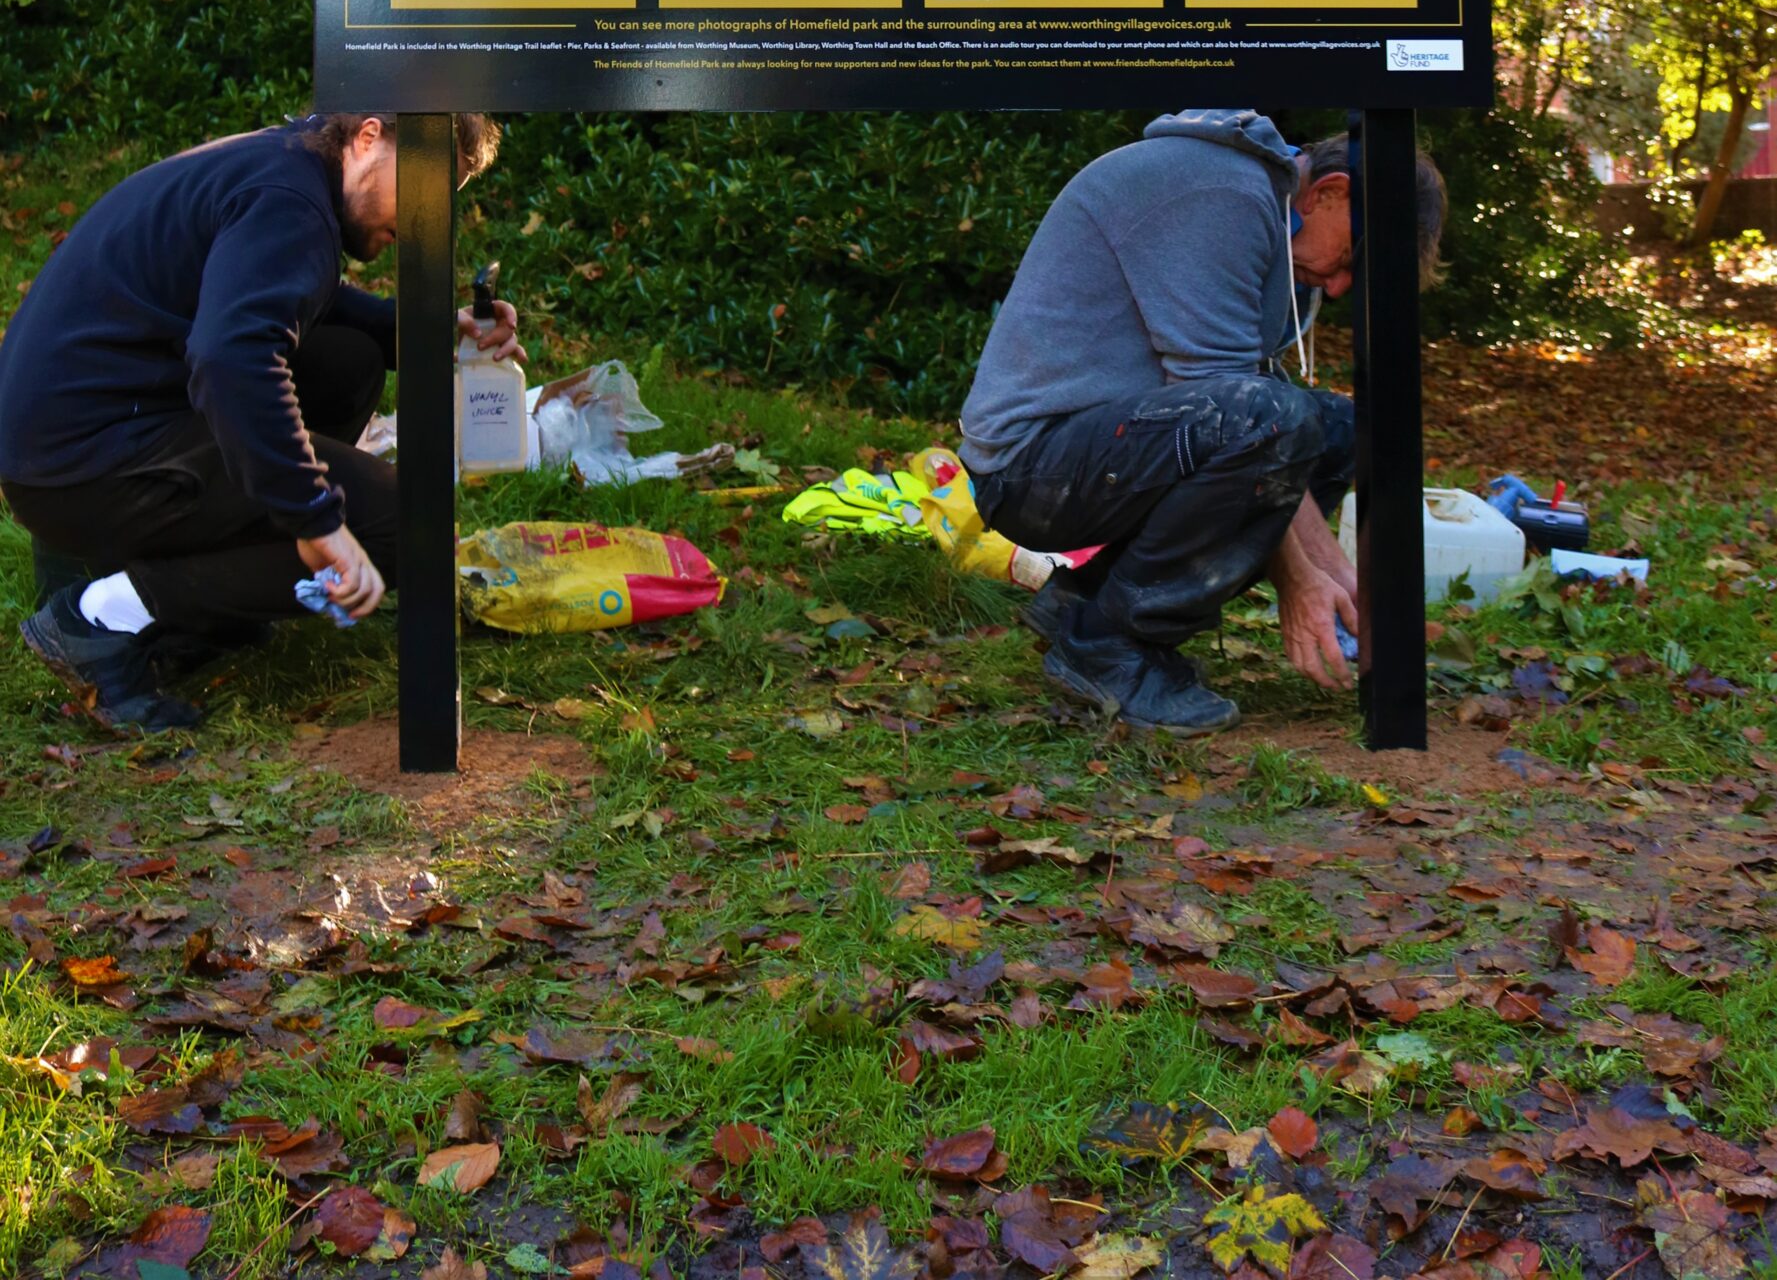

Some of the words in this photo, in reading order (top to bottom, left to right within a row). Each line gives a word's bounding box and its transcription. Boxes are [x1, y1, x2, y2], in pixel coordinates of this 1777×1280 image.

[594, 19, 615, 30] You
[619, 22, 639, 30] can
[642, 22, 661, 30] see
[665, 22, 694, 30] more
[698, 18, 771, 32] photographs
[774, 18, 786, 29] of
[790, 18, 849, 29] Homefield
[852, 18, 878, 32] park
[881, 18, 902, 29] and
[905, 18, 924, 29] the
[927, 18, 995, 32] surrounding
[998, 21, 1022, 29] area
[1026, 20, 1036, 29] at
[1039, 18, 1231, 31] www.worthingvillagevoices.org.uk
[345, 42, 381, 50] Homefield
[458, 42, 491, 51] Worthing
[492, 42, 523, 51] Heritage
[567, 42, 582, 50] Pier,
[611, 41, 639, 49] Seafront
[645, 41, 676, 49] available
[677, 41, 694, 49] from
[695, 41, 727, 50] Worthing
[729, 41, 760, 49] Museum,
[761, 41, 793, 50] Worthing
[795, 41, 820, 50] Library,
[821, 41, 853, 50] Worthing
[1143, 40, 1165, 49] phone
[1180, 40, 1200, 48] which
[1214, 40, 1228, 48] also
[1239, 40, 1259, 48] found
[1410, 53, 1450, 61] HERITAGE
[593, 60, 609, 68] The
[611, 59, 642, 68] Friends
[644, 59, 653, 68] of
[655, 59, 699, 68] Homefield
[701, 59, 719, 68] Park
[737, 59, 765, 69] always
[767, 59, 798, 69] looking
[800, 59, 812, 68] for
[834, 60, 879, 69] supporters
[880, 59, 896, 68] and
[918, 59, 940, 67] ideas
[942, 58, 954, 67] for
[955, 59, 969, 67] the
[971, 58, 992, 69] park.
[994, 59, 1009, 67] You
[1059, 58, 1081, 67] them
